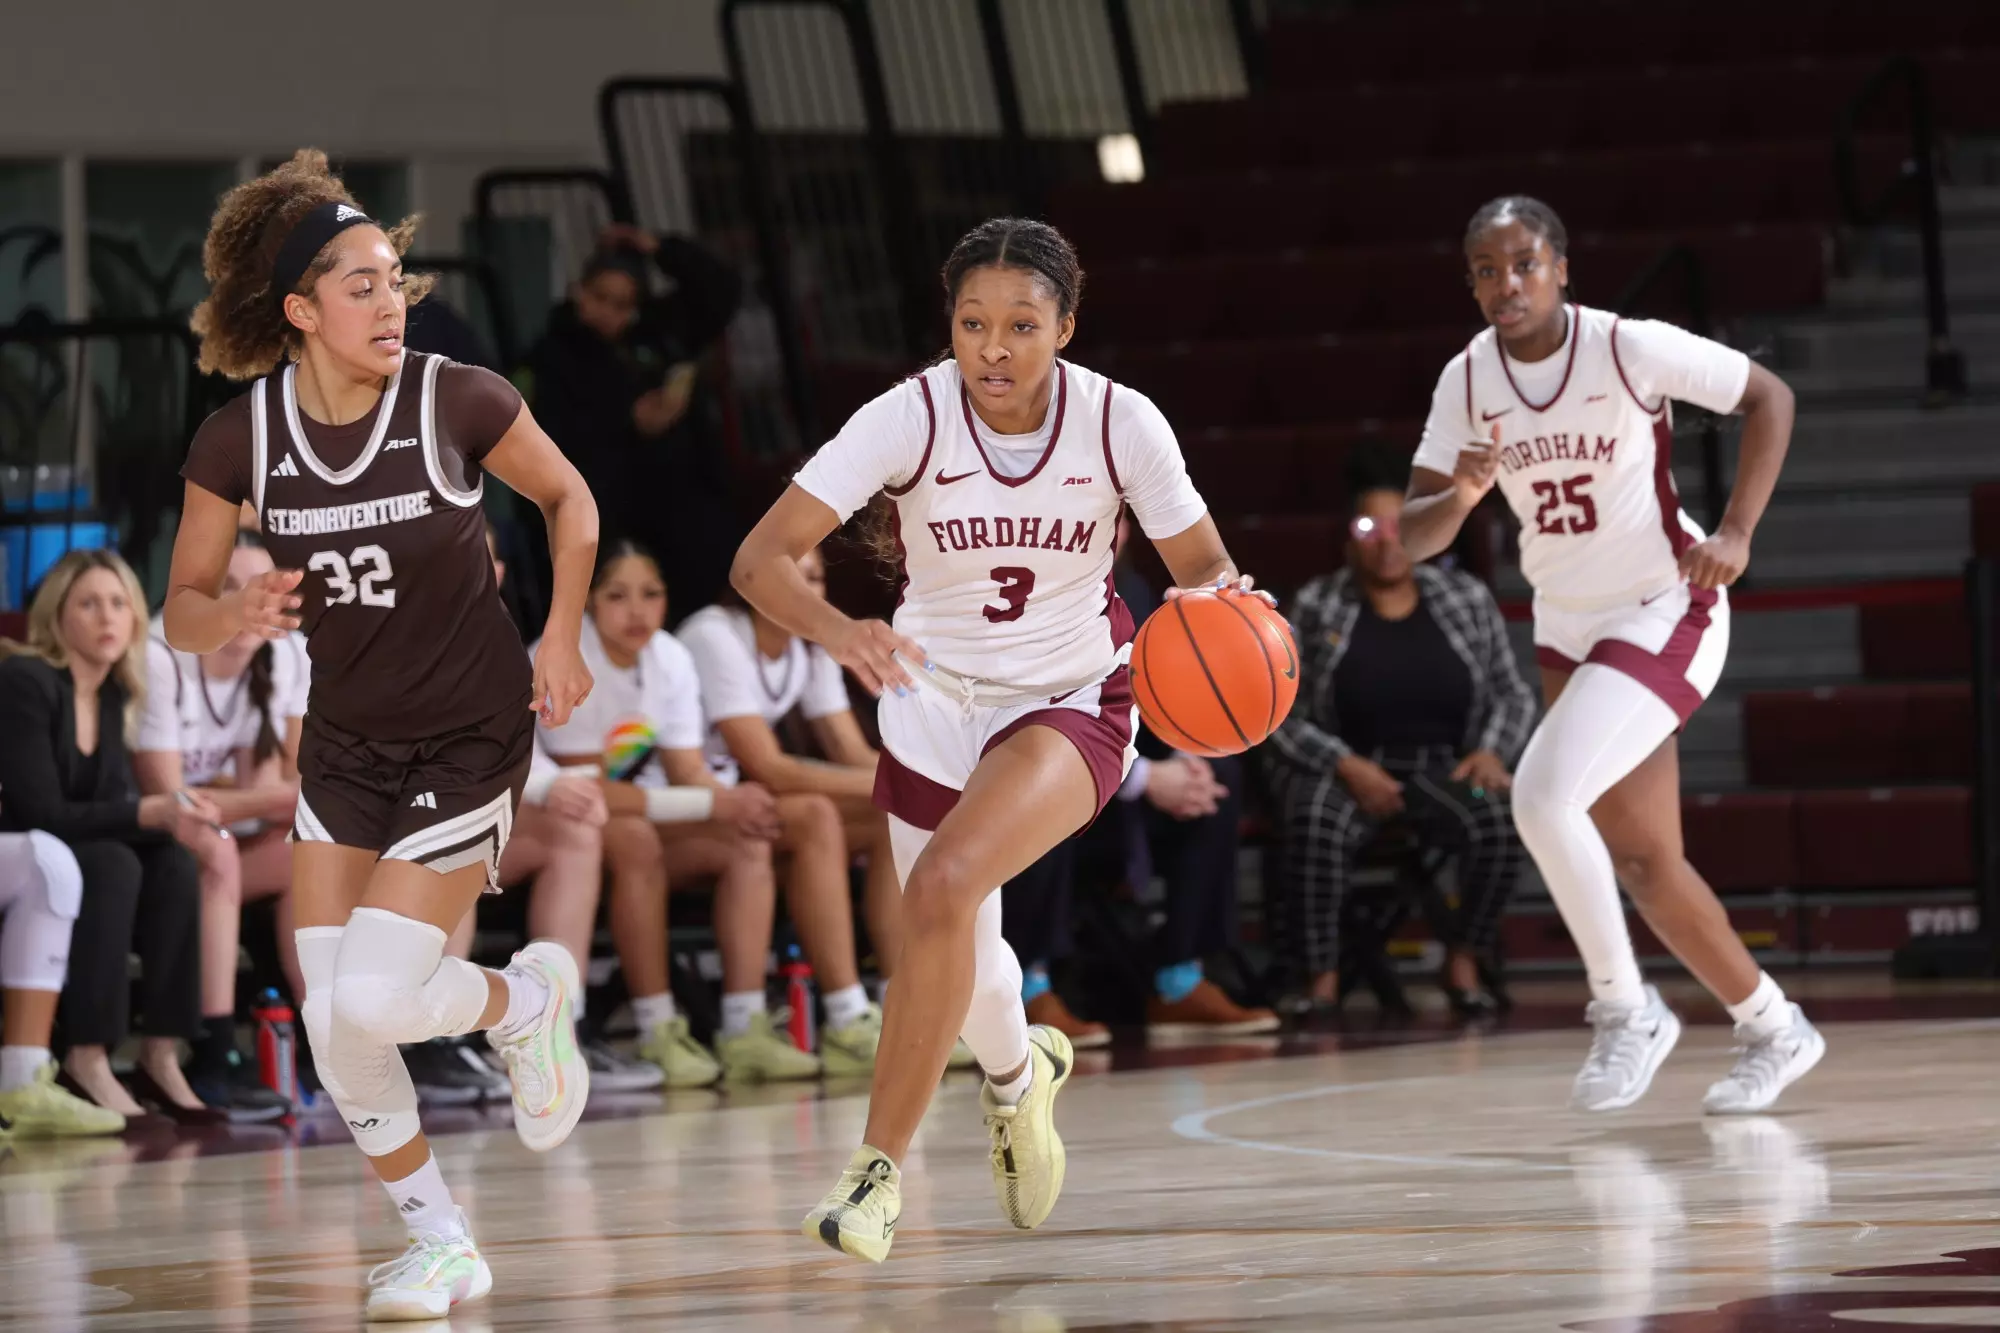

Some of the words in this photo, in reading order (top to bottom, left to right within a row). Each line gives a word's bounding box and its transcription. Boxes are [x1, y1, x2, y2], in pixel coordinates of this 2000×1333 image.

[267, 490, 433, 536] ST.BONAVENTURE
[1531, 473, 1598, 534] 25
[927, 516, 1097, 554] FORDHAM
[307, 544, 396, 609] 32
[982, 566, 1036, 623] 3
